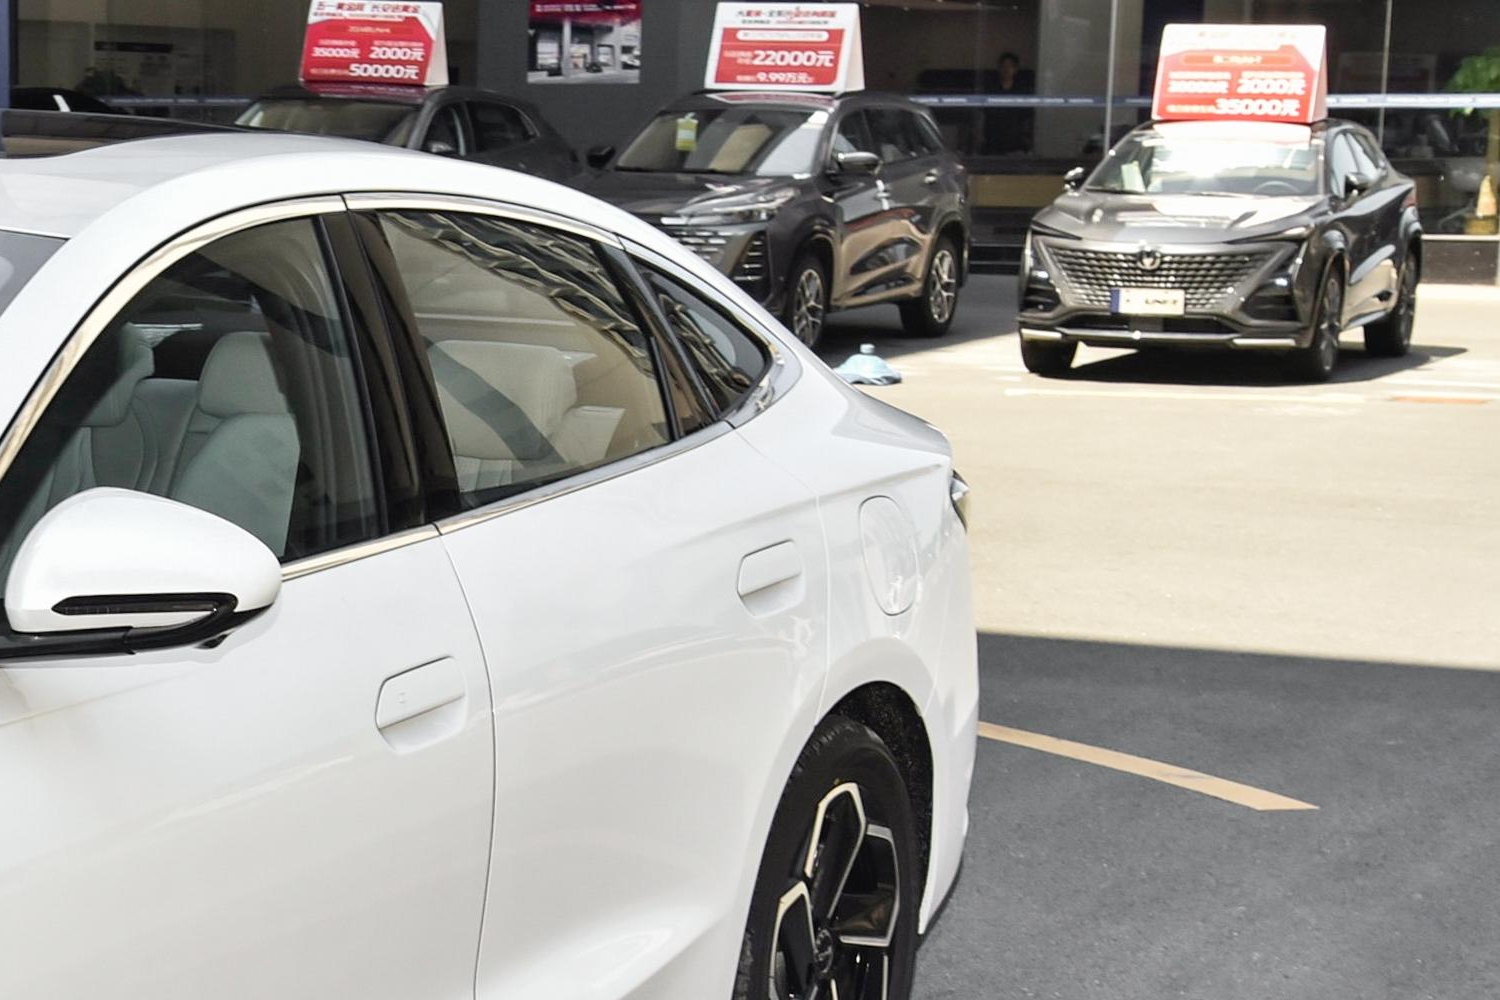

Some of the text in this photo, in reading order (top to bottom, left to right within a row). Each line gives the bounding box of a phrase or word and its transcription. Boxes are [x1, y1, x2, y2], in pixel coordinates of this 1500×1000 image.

[368, 46, 425, 61] 2000元
[752, 50, 834, 67] 22000元
[348, 63, 419, 79] 50000元
